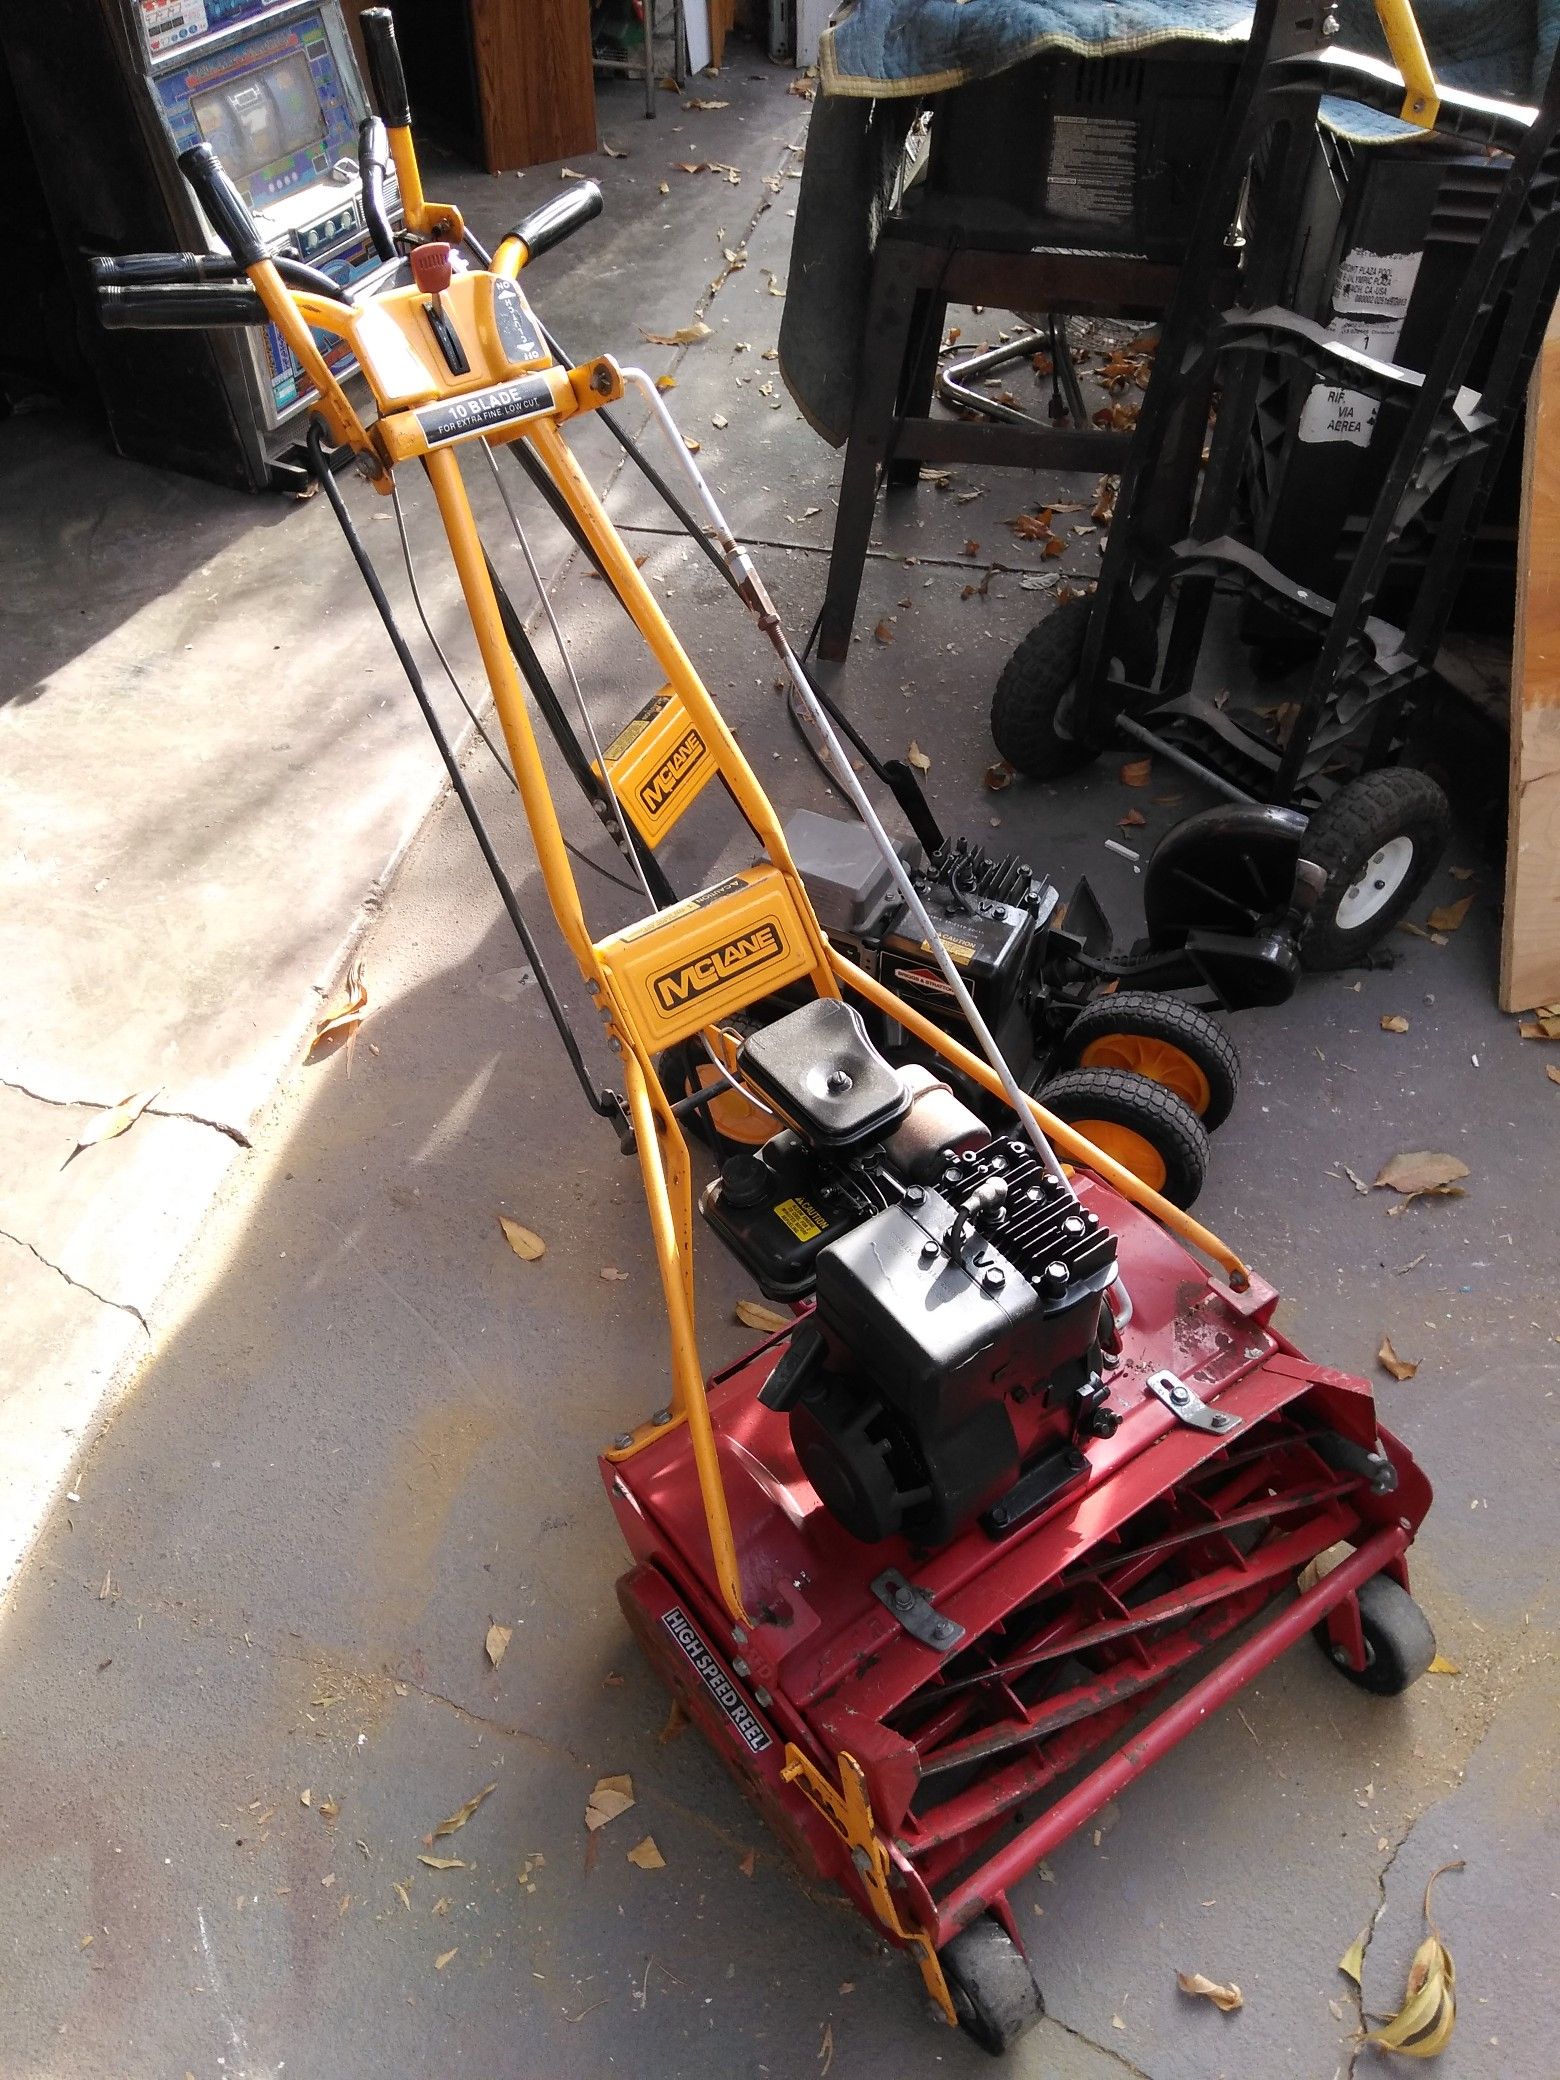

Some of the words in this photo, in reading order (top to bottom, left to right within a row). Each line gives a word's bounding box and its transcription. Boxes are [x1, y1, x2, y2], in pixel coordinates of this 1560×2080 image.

[495, 281, 511, 290] ON
[448, 406, 468, 421] 10
[467, 387, 522, 414] BLADE
[1338, 406, 1354, 418] VIA
[438, 421, 456, 434] FOR
[456, 414, 483, 428] EXTRA
[505, 402, 522, 415] LOW
[697, 884, 733, 905] CAUTION
[942, 933, 977, 949] CAUTION
[801, 1202, 830, 1230] CAUTION
[665, 1610, 704, 1658] HIGH
[696, 1655, 738, 1708] SPEED
[731, 1705, 770, 1749] REEL
